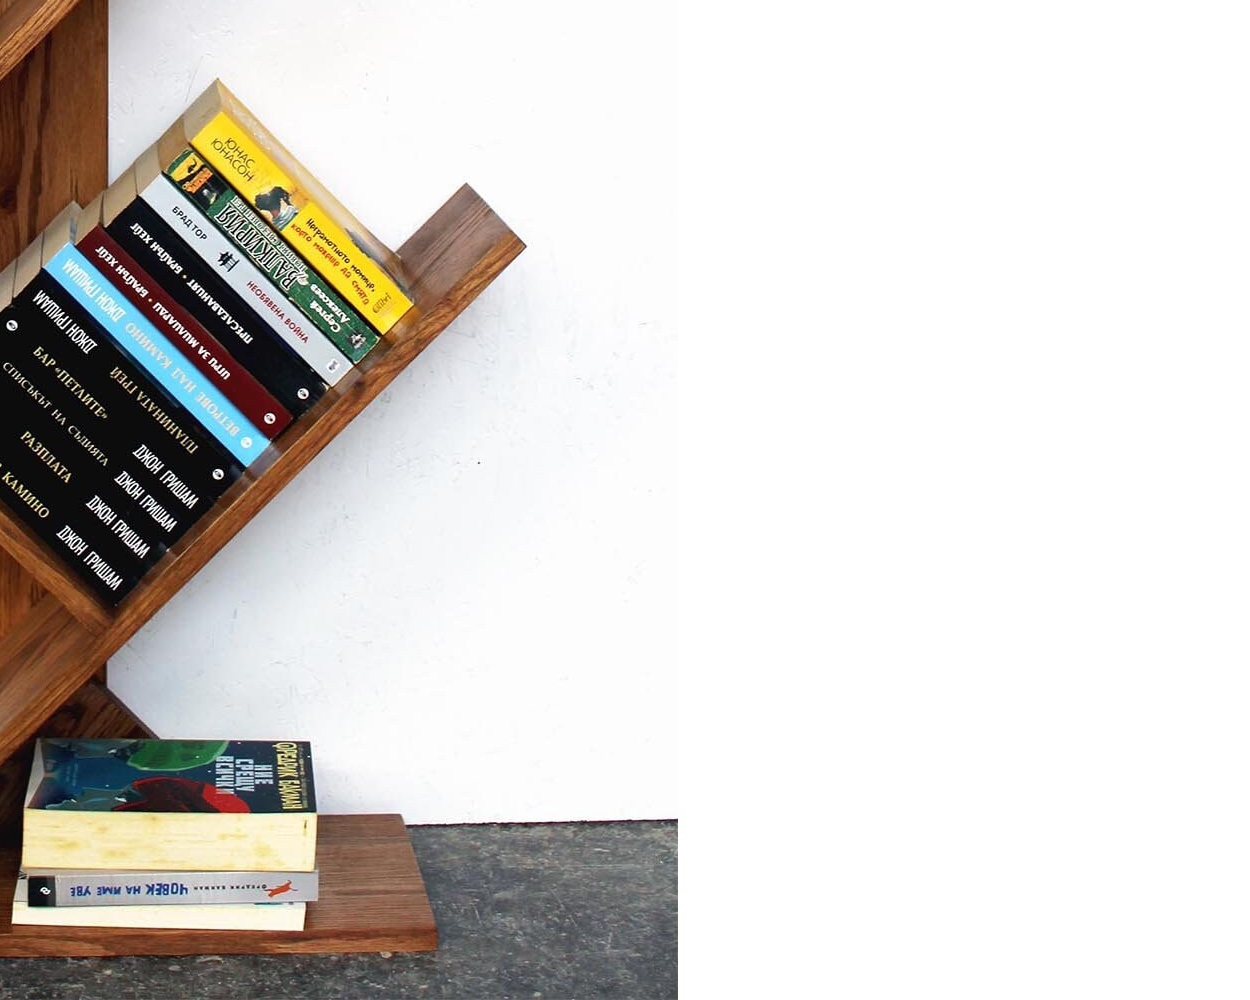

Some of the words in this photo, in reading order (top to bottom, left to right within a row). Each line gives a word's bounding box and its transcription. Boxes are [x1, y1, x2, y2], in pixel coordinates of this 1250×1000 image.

[209, 136, 256, 184] ЮНАСОН
[222, 136, 256, 170] ЮНАС
[127, 219, 154, 246] ХЕЙГ
[170, 204, 194, 228] БРАД
[189, 223, 209, 243] ТОР
[92, 243, 119, 270] ХЕЙГ
[147, 239, 184, 277] БРАЙЪН
[212, 200, 304, 293] ВАЛКИРИЯ
[59, 256, 102, 300] ГРИШАМ
[112, 263, 150, 300] БРАЙЪН
[30, 288, 73, 331] ГРИШАМ
[92, 290, 127, 324] ДЖОН
[184, 276, 254, 346] ПРЕСЛЕДВАНИЯТ
[244, 279, 287, 321] НЕОБЯВЕНА
[282, 315, 312, 345] ВОЙНА
[306, 281, 351, 327] Алексеев
[307, 297, 344, 335] Сергей
[63, 321, 98, 356] ДЖОН
[151, 300, 200, 349] МИЛИАРДИ
[122, 319, 173, 370] КАМИНО
[195, 344, 211, 361] ЗА
[31, 344, 58, 371] БАР
[50, 363, 111, 423] «ПЕТЛИТЕ»
[107, 364, 139, 397] ГРЕЙ
[169, 366, 198, 394] НАД
[206, 355, 232, 381] ИГРИ
[0, 359, 53, 412] СПИСЪКЪТ
[49, 407, 69, 427] НА
[65, 422, 111, 469] СЪДИЯТА
[132, 389, 199, 456] ПЛАНИНАТА
[193, 390, 242, 438] ВЕТРОВЕ
[18, 428, 75, 485] РАЗПЛАТА
[130, 441, 165, 476] ДЖОН
[157, 467, 201, 511] ГРИШАМ
[0, 469, 52, 521] КАМИНО
[112, 468, 146, 502] ДЖОН
[137, 492, 179, 534] ГРИШАМ
[84, 493, 118, 527] ДЖОН
[109, 517, 152, 560] ГРИШАМ
[54, 522, 90, 558] ДЖОН
[81, 548, 125, 592] ГРИШАМ
[214, 754, 236, 796] ВСИЧКИ
[234, 757, 256, 793] СРЕЩУ
[253, 763, 275, 785] НИЕ
[271, 741, 300, 779] ФРЕДРИК
[277, 779, 304, 811] БАКМАН
[69, 884, 93, 898] УВЕ
[95, 884, 123, 897] ИМЕ
[124, 884, 142, 896] НА
[144, 881, 189, 897] ЧОВЕК
